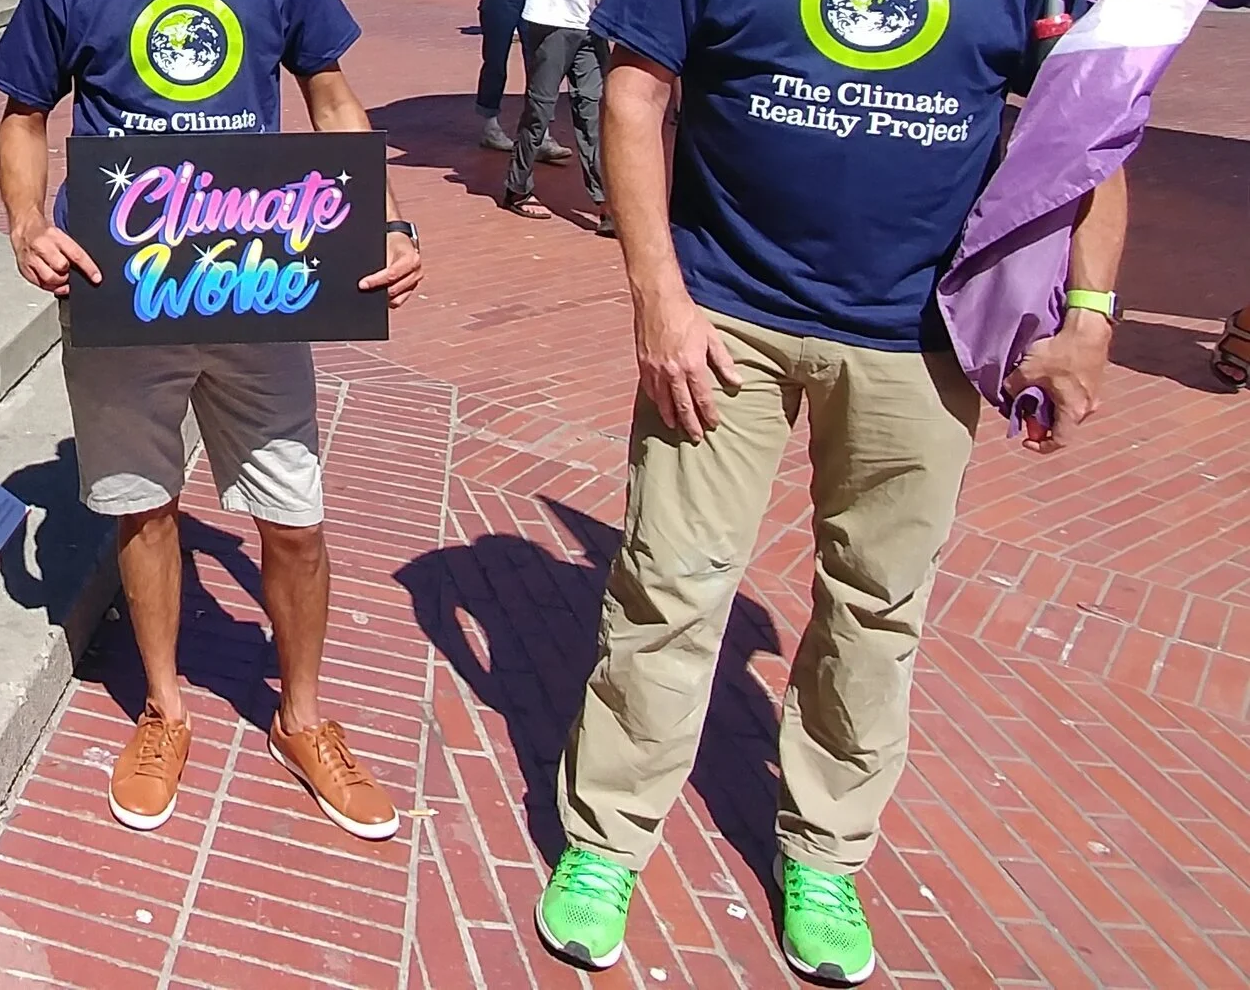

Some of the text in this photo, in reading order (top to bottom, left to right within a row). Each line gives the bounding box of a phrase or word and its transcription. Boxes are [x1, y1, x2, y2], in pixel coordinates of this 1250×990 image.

[748, 94, 862, 138] Reality
[771, 74, 960, 116] The Climate
[120, 110, 167, 133] The
[171, 109, 257, 133] Climate
[109, 160, 352, 254] Climate
[124, 238, 323, 323] Woke
